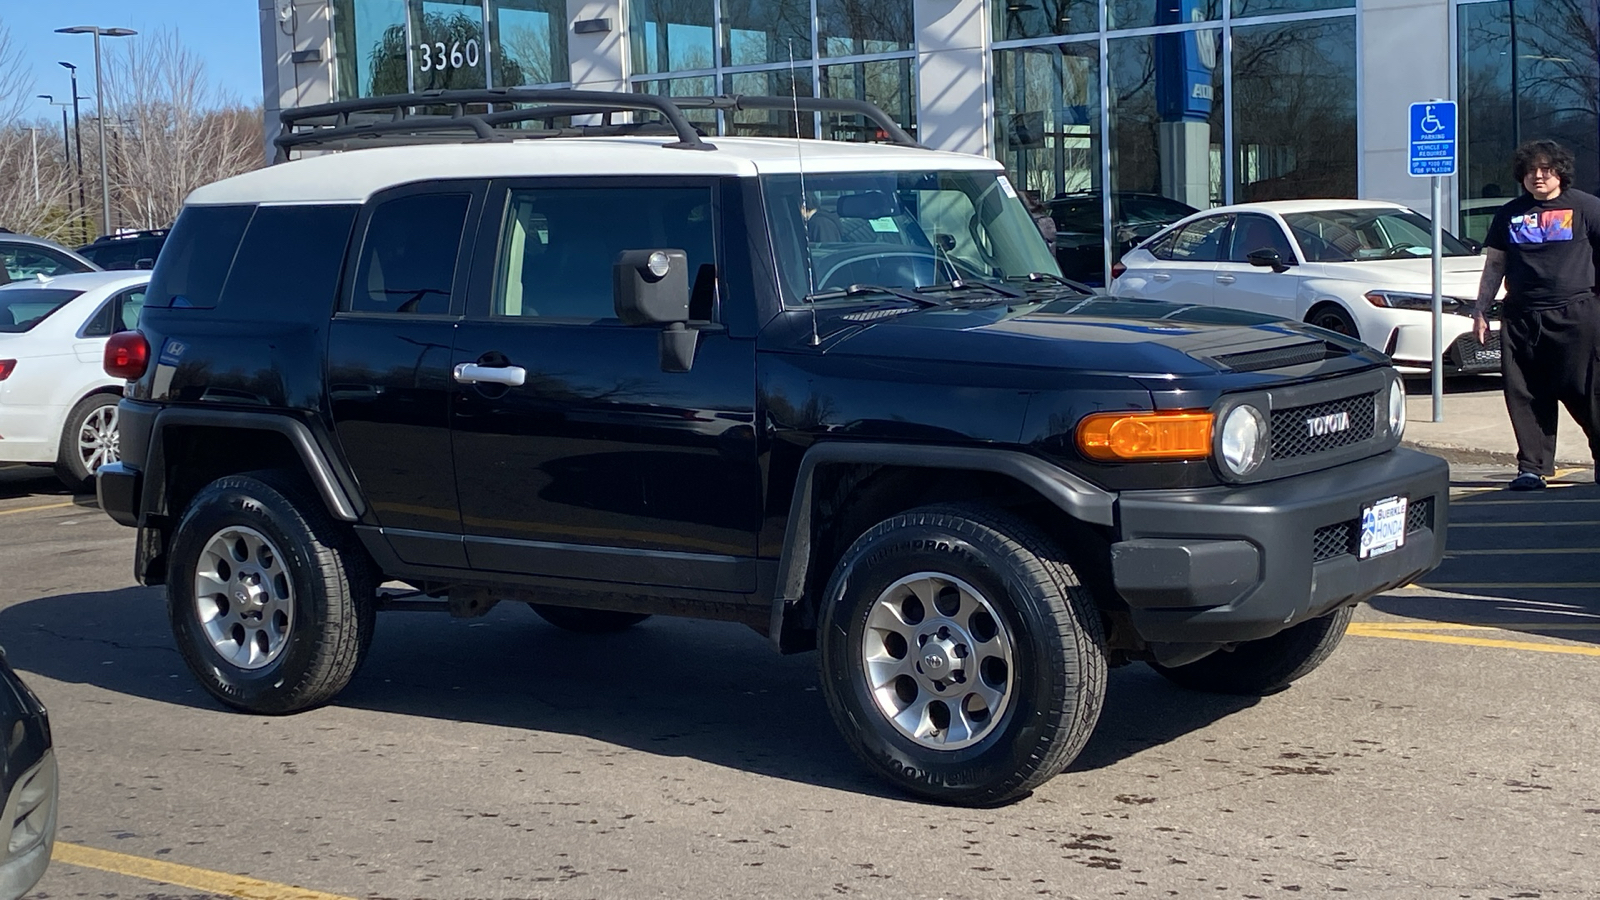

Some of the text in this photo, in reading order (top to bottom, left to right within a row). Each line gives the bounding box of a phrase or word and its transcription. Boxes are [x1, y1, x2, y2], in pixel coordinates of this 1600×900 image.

[420, 38, 479, 72] 3360
[1306, 411, 1350, 438] TOYOTA
[1377, 504, 1406, 521] BUERKLE
[1375, 520, 1403, 541] HONDA
